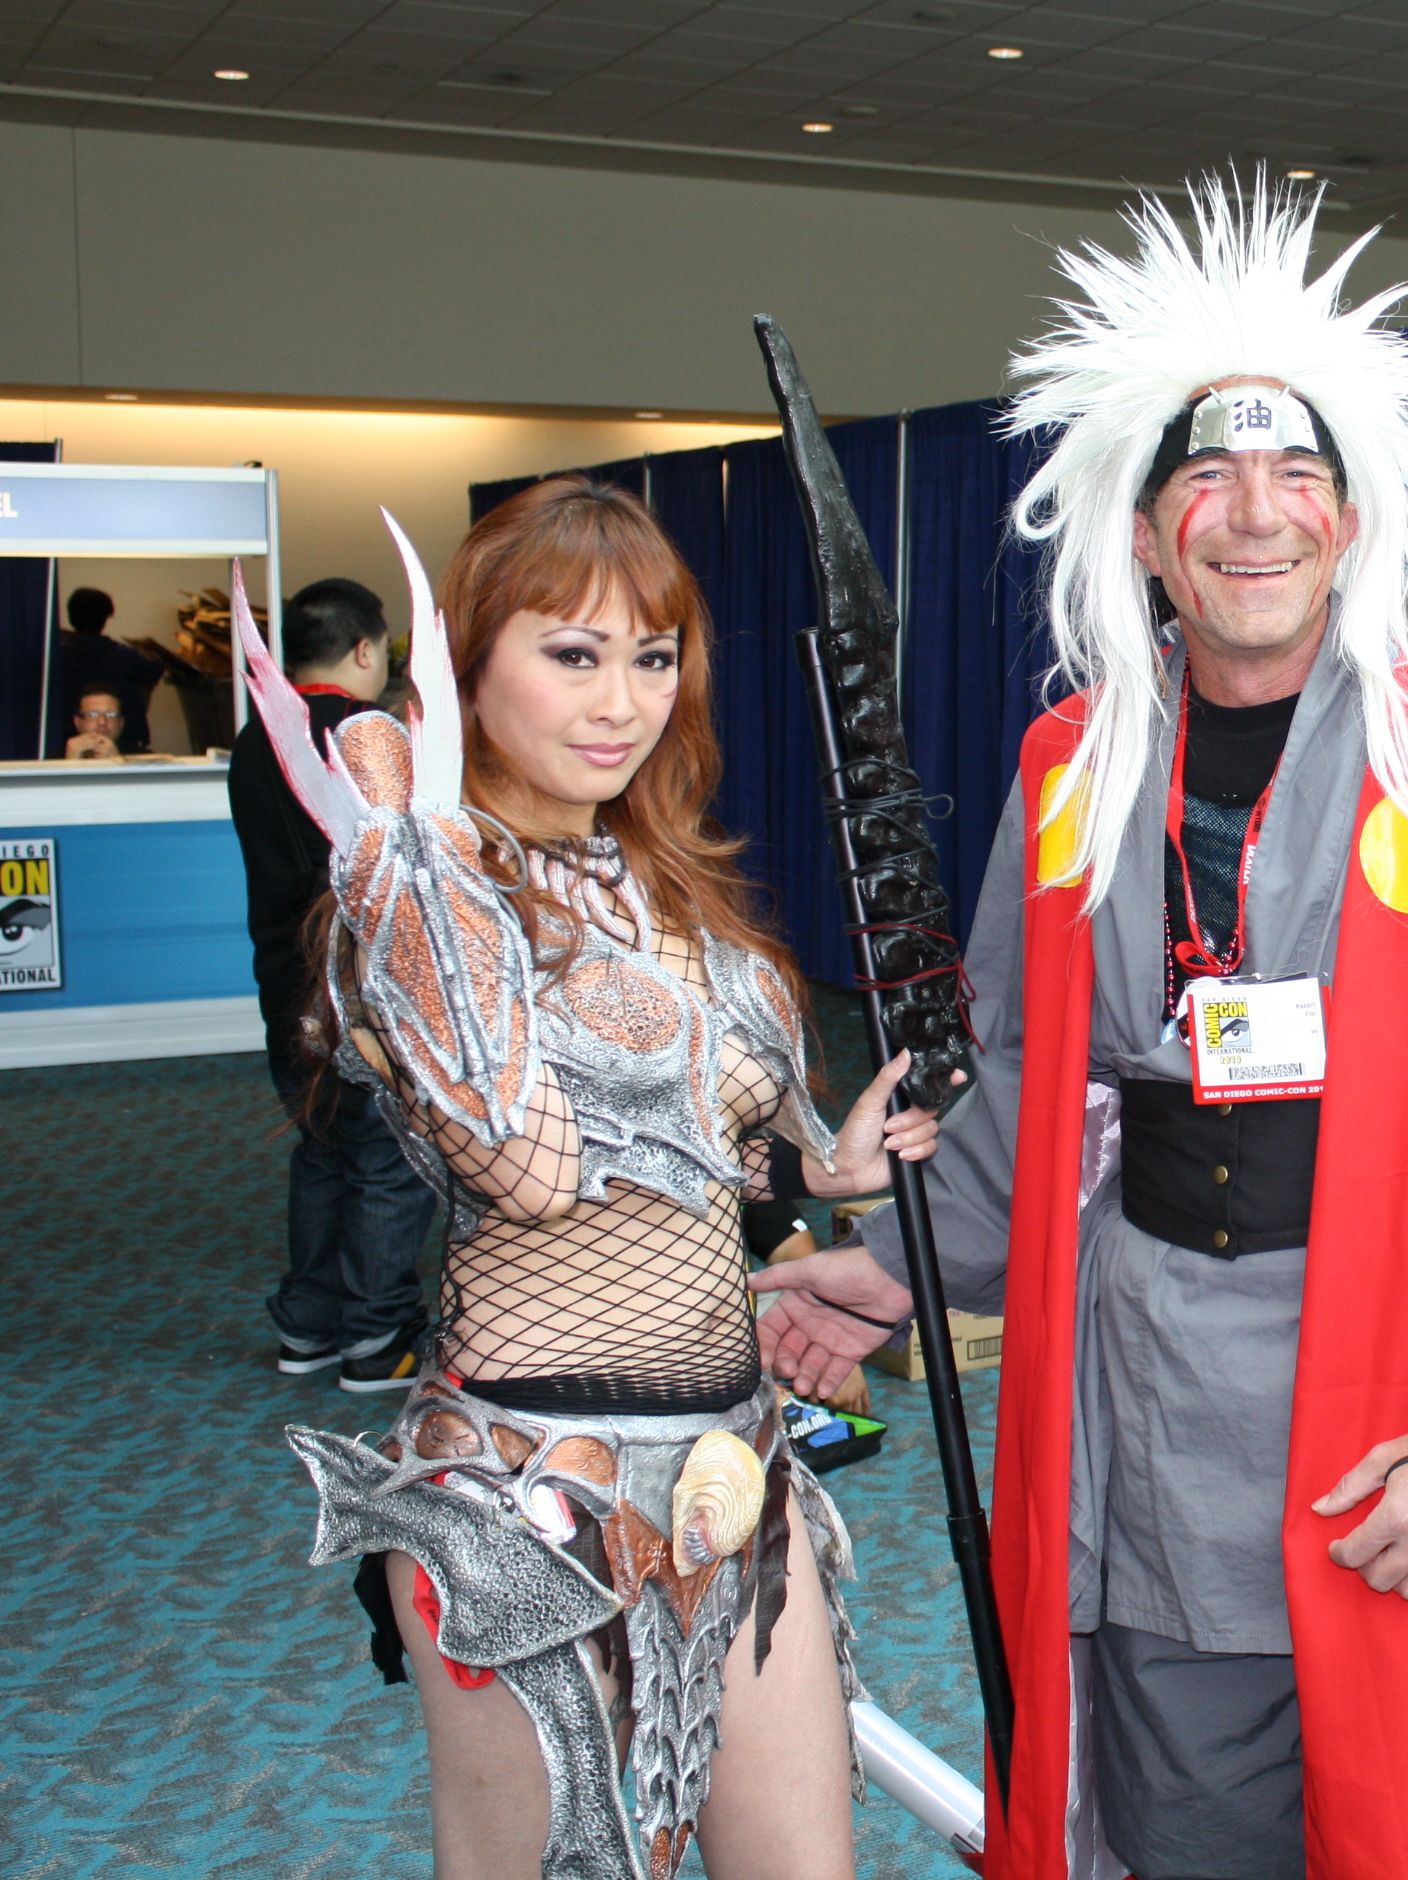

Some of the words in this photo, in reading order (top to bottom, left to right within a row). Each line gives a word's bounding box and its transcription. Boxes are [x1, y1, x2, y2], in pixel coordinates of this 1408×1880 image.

[1232, 399, 1272, 432] 油
[0, 968, 55, 984] TIONAL
[1218, 1002, 1248, 1017] CON
[1203, 1003, 1222, 1048] COMIC
[1203, 1091, 1221, 1099] SAN
[1223, 1089, 1253, 1097] DIEGO
[1254, 1086, 1306, 1096] COMIC-CON
